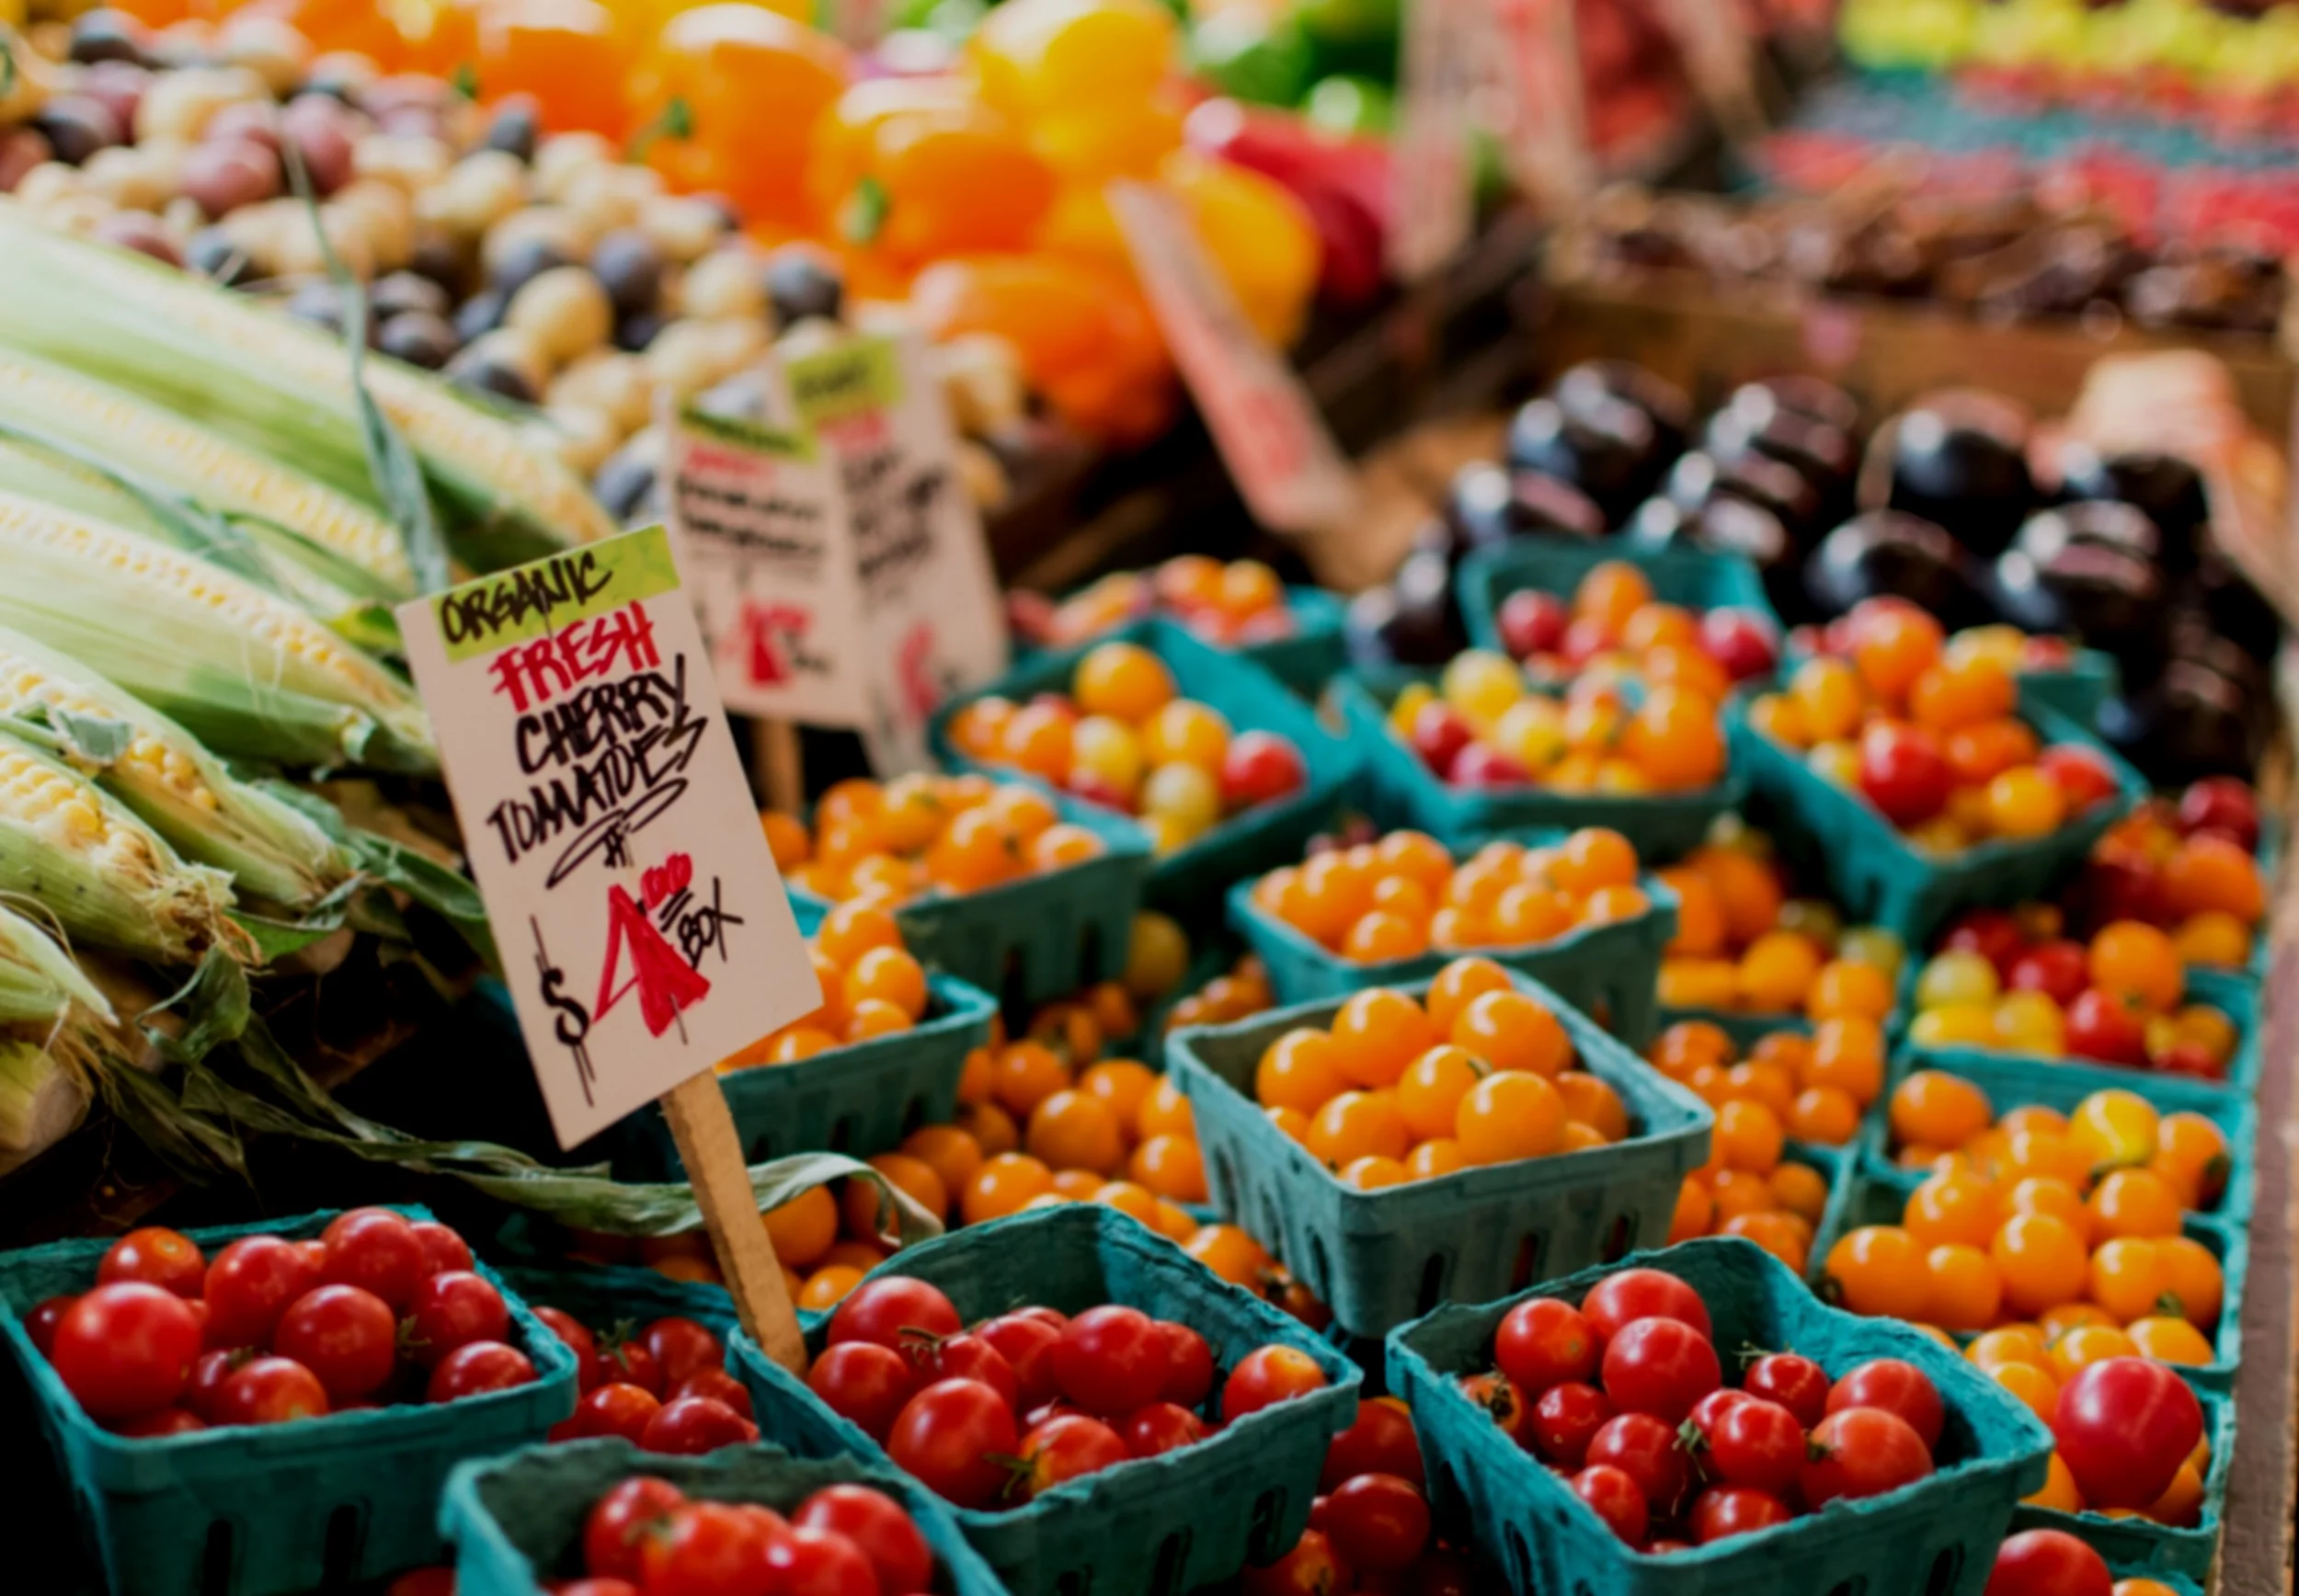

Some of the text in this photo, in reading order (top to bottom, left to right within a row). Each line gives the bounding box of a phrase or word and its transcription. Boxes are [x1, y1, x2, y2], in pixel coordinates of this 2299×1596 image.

[440, 552, 613, 644] ORGANIC
[487, 599, 661, 713] FRESH
[515, 654, 686, 775] CHERRY
[486, 706, 708, 865] TOMATOES
[677, 876, 745, 972] BOX
